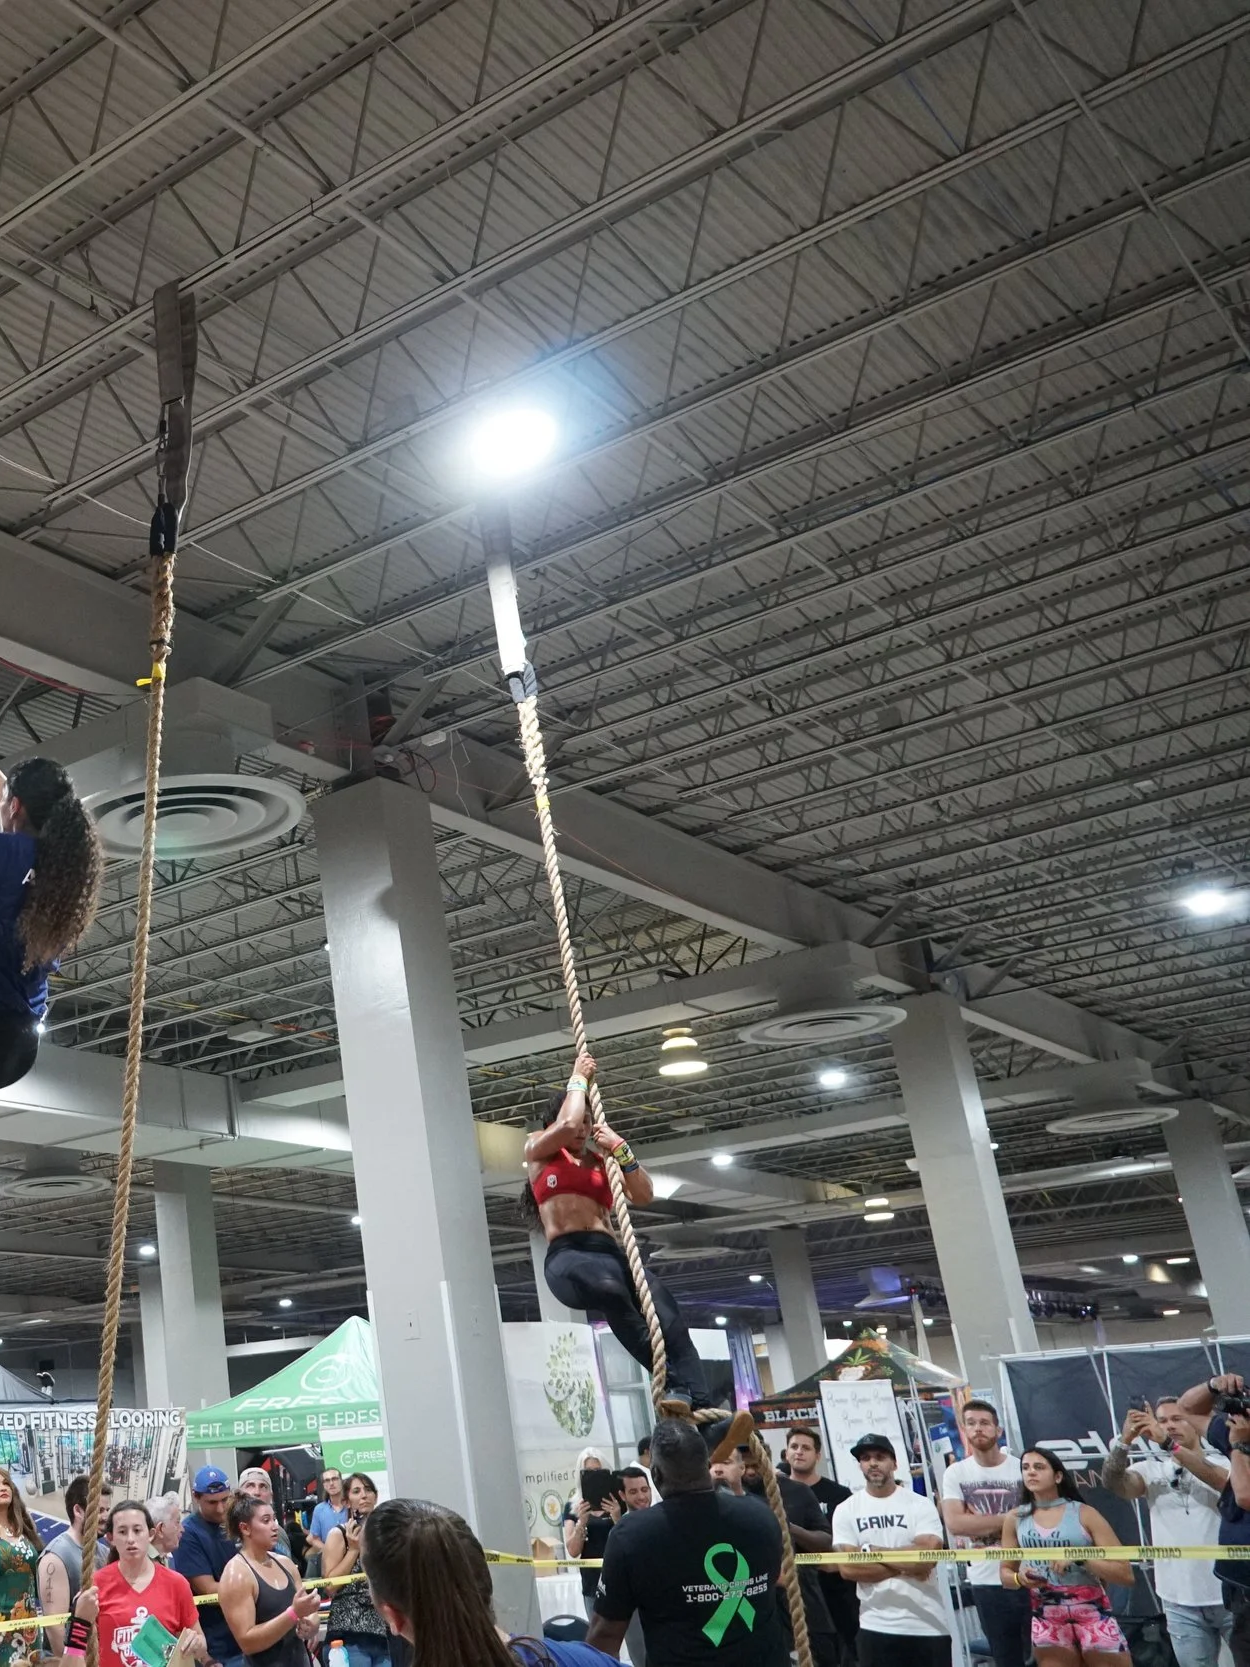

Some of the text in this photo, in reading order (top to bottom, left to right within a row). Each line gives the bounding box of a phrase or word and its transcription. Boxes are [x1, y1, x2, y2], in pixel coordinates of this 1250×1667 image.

[29, 1409, 97, 1431] FITNESS
[107, 1409, 181, 1429] LOORING
[764, 1408, 818, 1423] BLACK
[200, 1422, 225, 1438] FIT.
[234, 1420, 256, 1436] BE
[260, 1416, 298, 1432] FED.
[306, 1413, 329, 1430] BE
[356, 1450, 386, 1461] FRES
[525, 1470, 569, 1485] mplified
[856, 1514, 908, 1533] GAINZ
[682, 1583, 729, 1593] VETERANS
[755, 1573, 769, 1584] LINE
[686, 1583, 768, 1603] 1-800-273-8255
